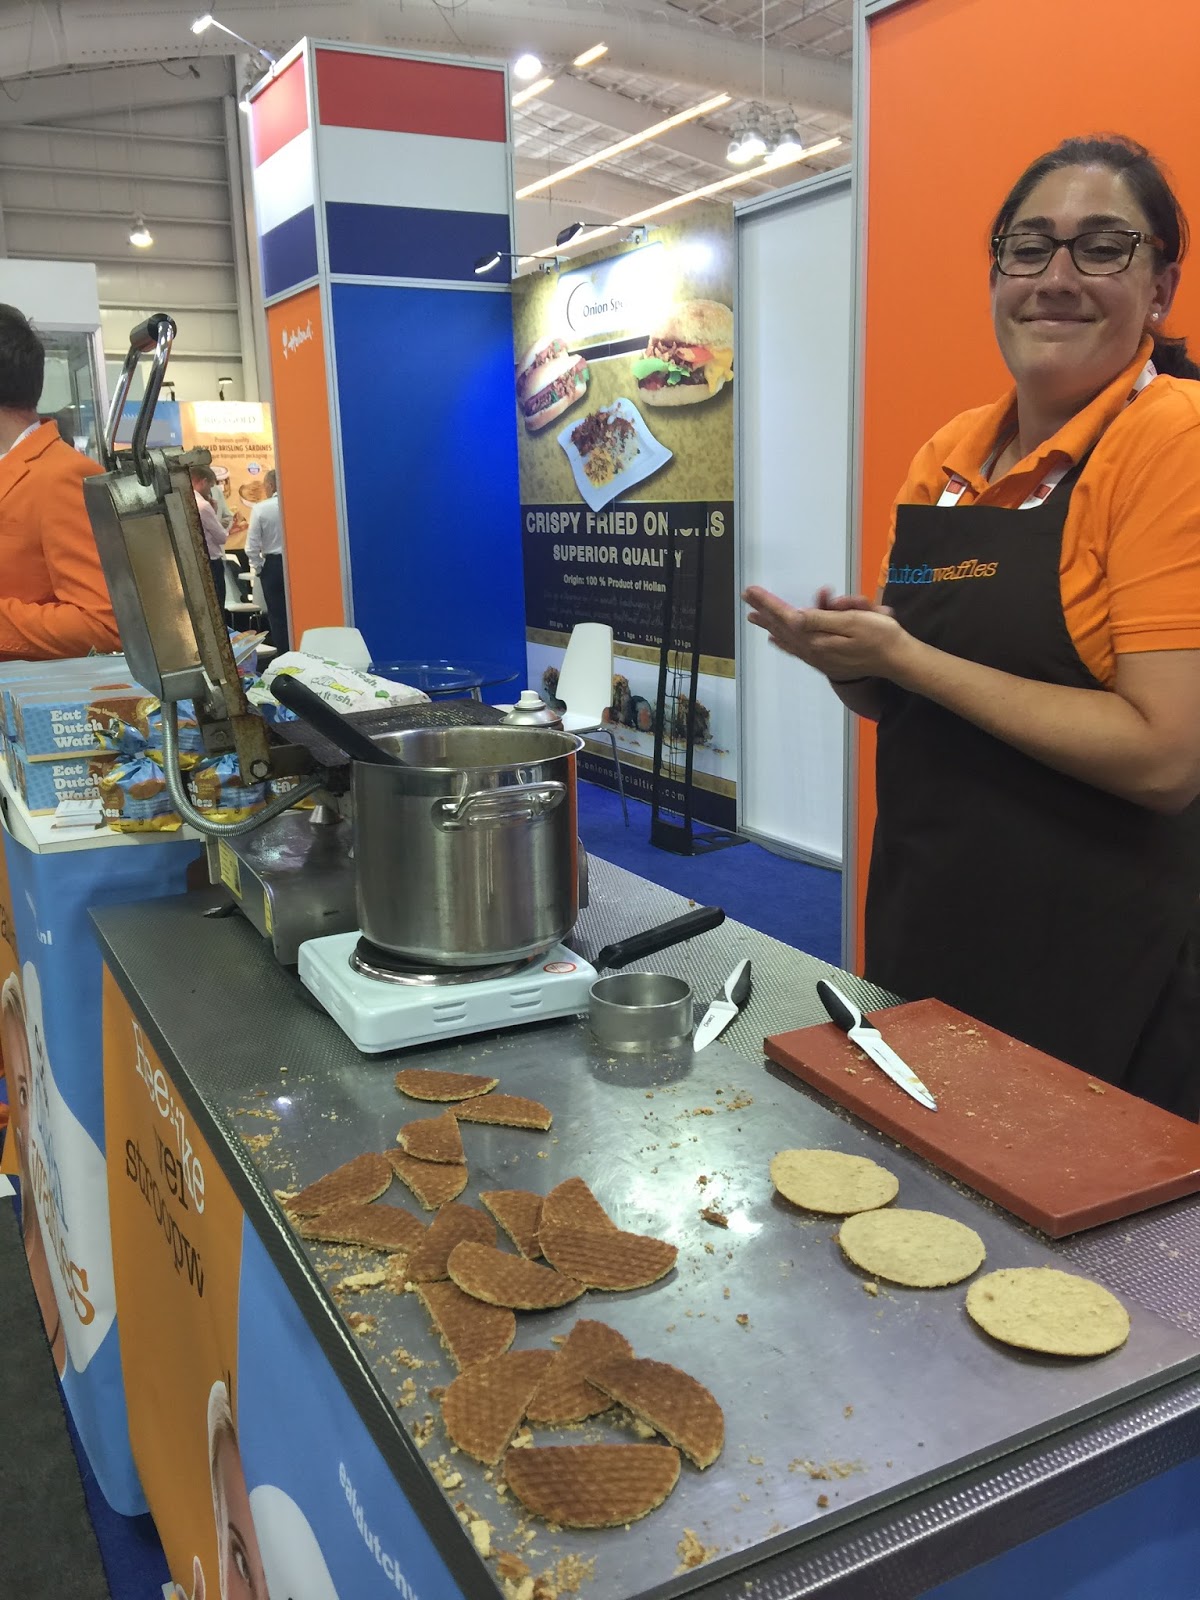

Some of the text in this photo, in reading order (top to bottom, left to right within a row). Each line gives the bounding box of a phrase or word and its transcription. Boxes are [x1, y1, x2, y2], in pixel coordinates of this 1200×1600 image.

[583, 302, 608, 317] Onion
[245, 444, 272, 452] SARDINES
[526, 511, 580, 534] CRISPY
[586, 511, 638, 536] FRIED
[553, 544, 683, 568] SUPERIOR QUALIY
[563, 574, 667, 593] Origin: 100 % Product of Hollan
[50, 709, 82, 722] Eat
[52, 719, 104, 735] Dutch
[52, 764, 84, 777] Eat
[53, 773, 103, 790] Dutch
